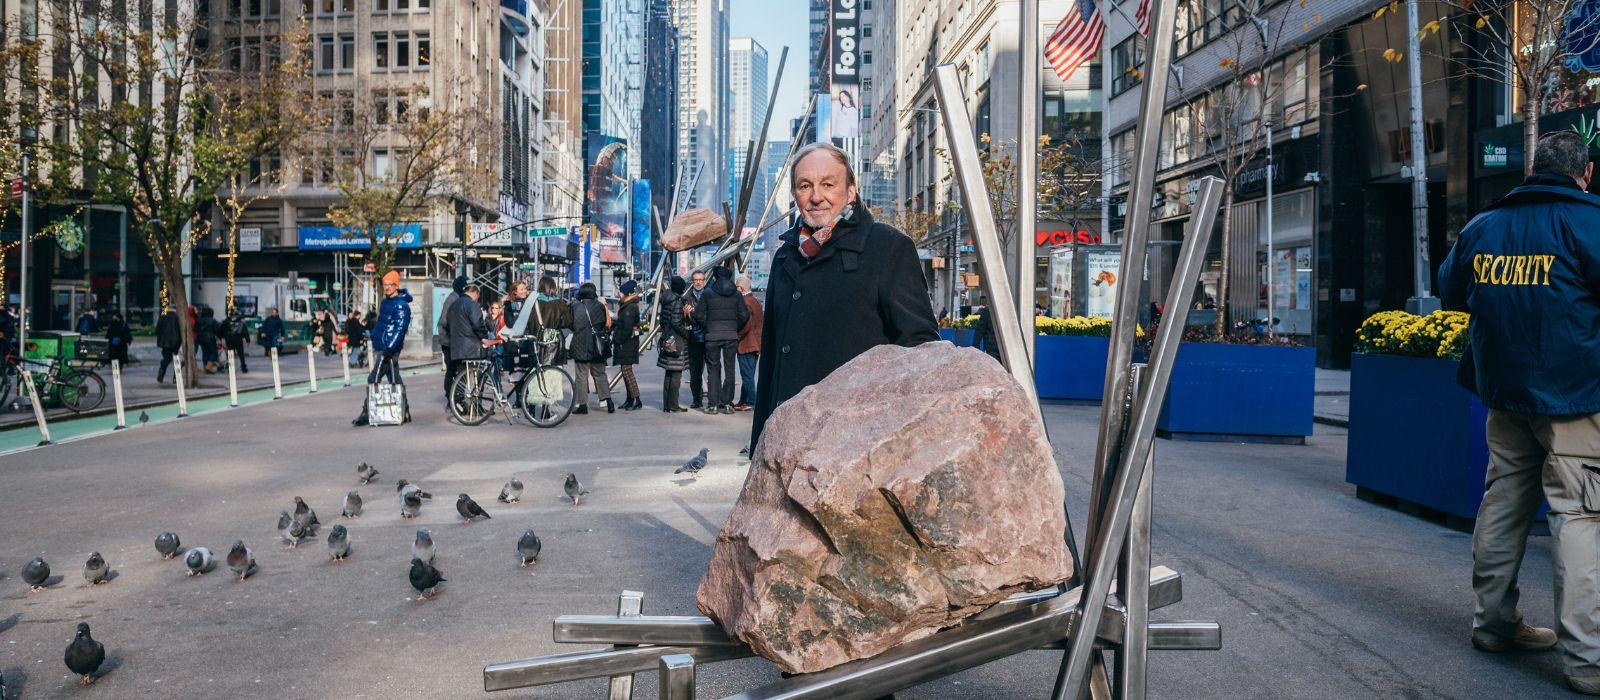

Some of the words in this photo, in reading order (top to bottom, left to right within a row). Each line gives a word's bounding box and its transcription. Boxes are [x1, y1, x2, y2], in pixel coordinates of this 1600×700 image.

[834, 26, 856, 75] Foot
[1494, 146, 1507, 155] CBD
[1483, 154, 1507, 163] KRATOM
[1240, 163, 1279, 187] pharmay
[537, 229, 543, 237] W
[1050, 229, 1090, 246] CVS
[304, 237, 347, 247] Metropolitan
[1473, 253, 1556, 286] SECURITY
